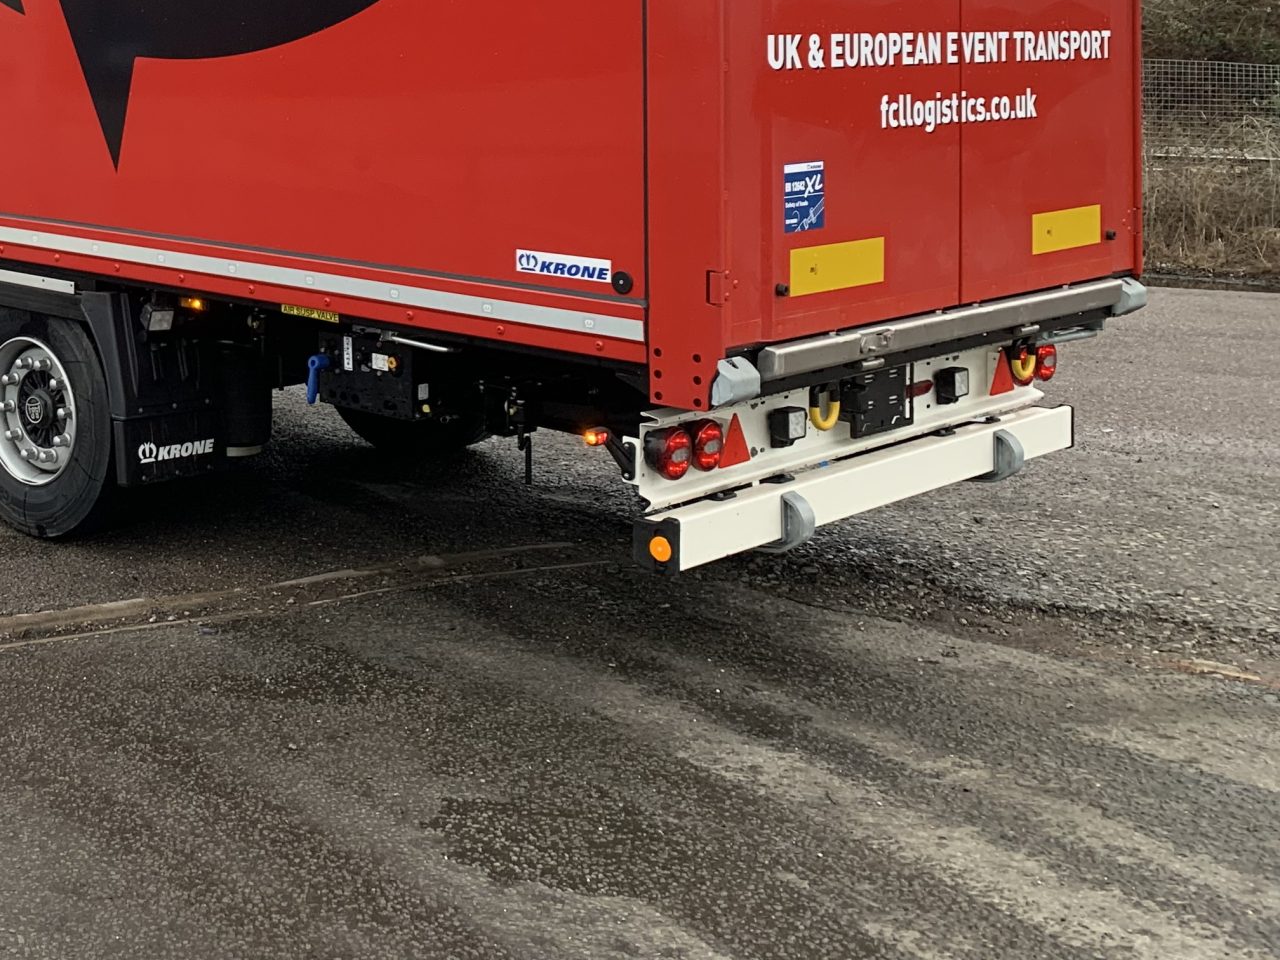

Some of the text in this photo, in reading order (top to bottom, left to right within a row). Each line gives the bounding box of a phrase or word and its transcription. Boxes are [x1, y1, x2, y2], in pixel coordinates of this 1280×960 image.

[766, 33, 803, 70] UK
[807, 33, 825, 69] &
[830, 31, 942, 69] EUROPEAN
[1013, 29, 1111, 62] TRANSPORT
[880, 87, 1038, 134] fcllogistics.co.uk
[540, 260, 610, 281] KRONE
[157, 438, 215, 461] KRONE
